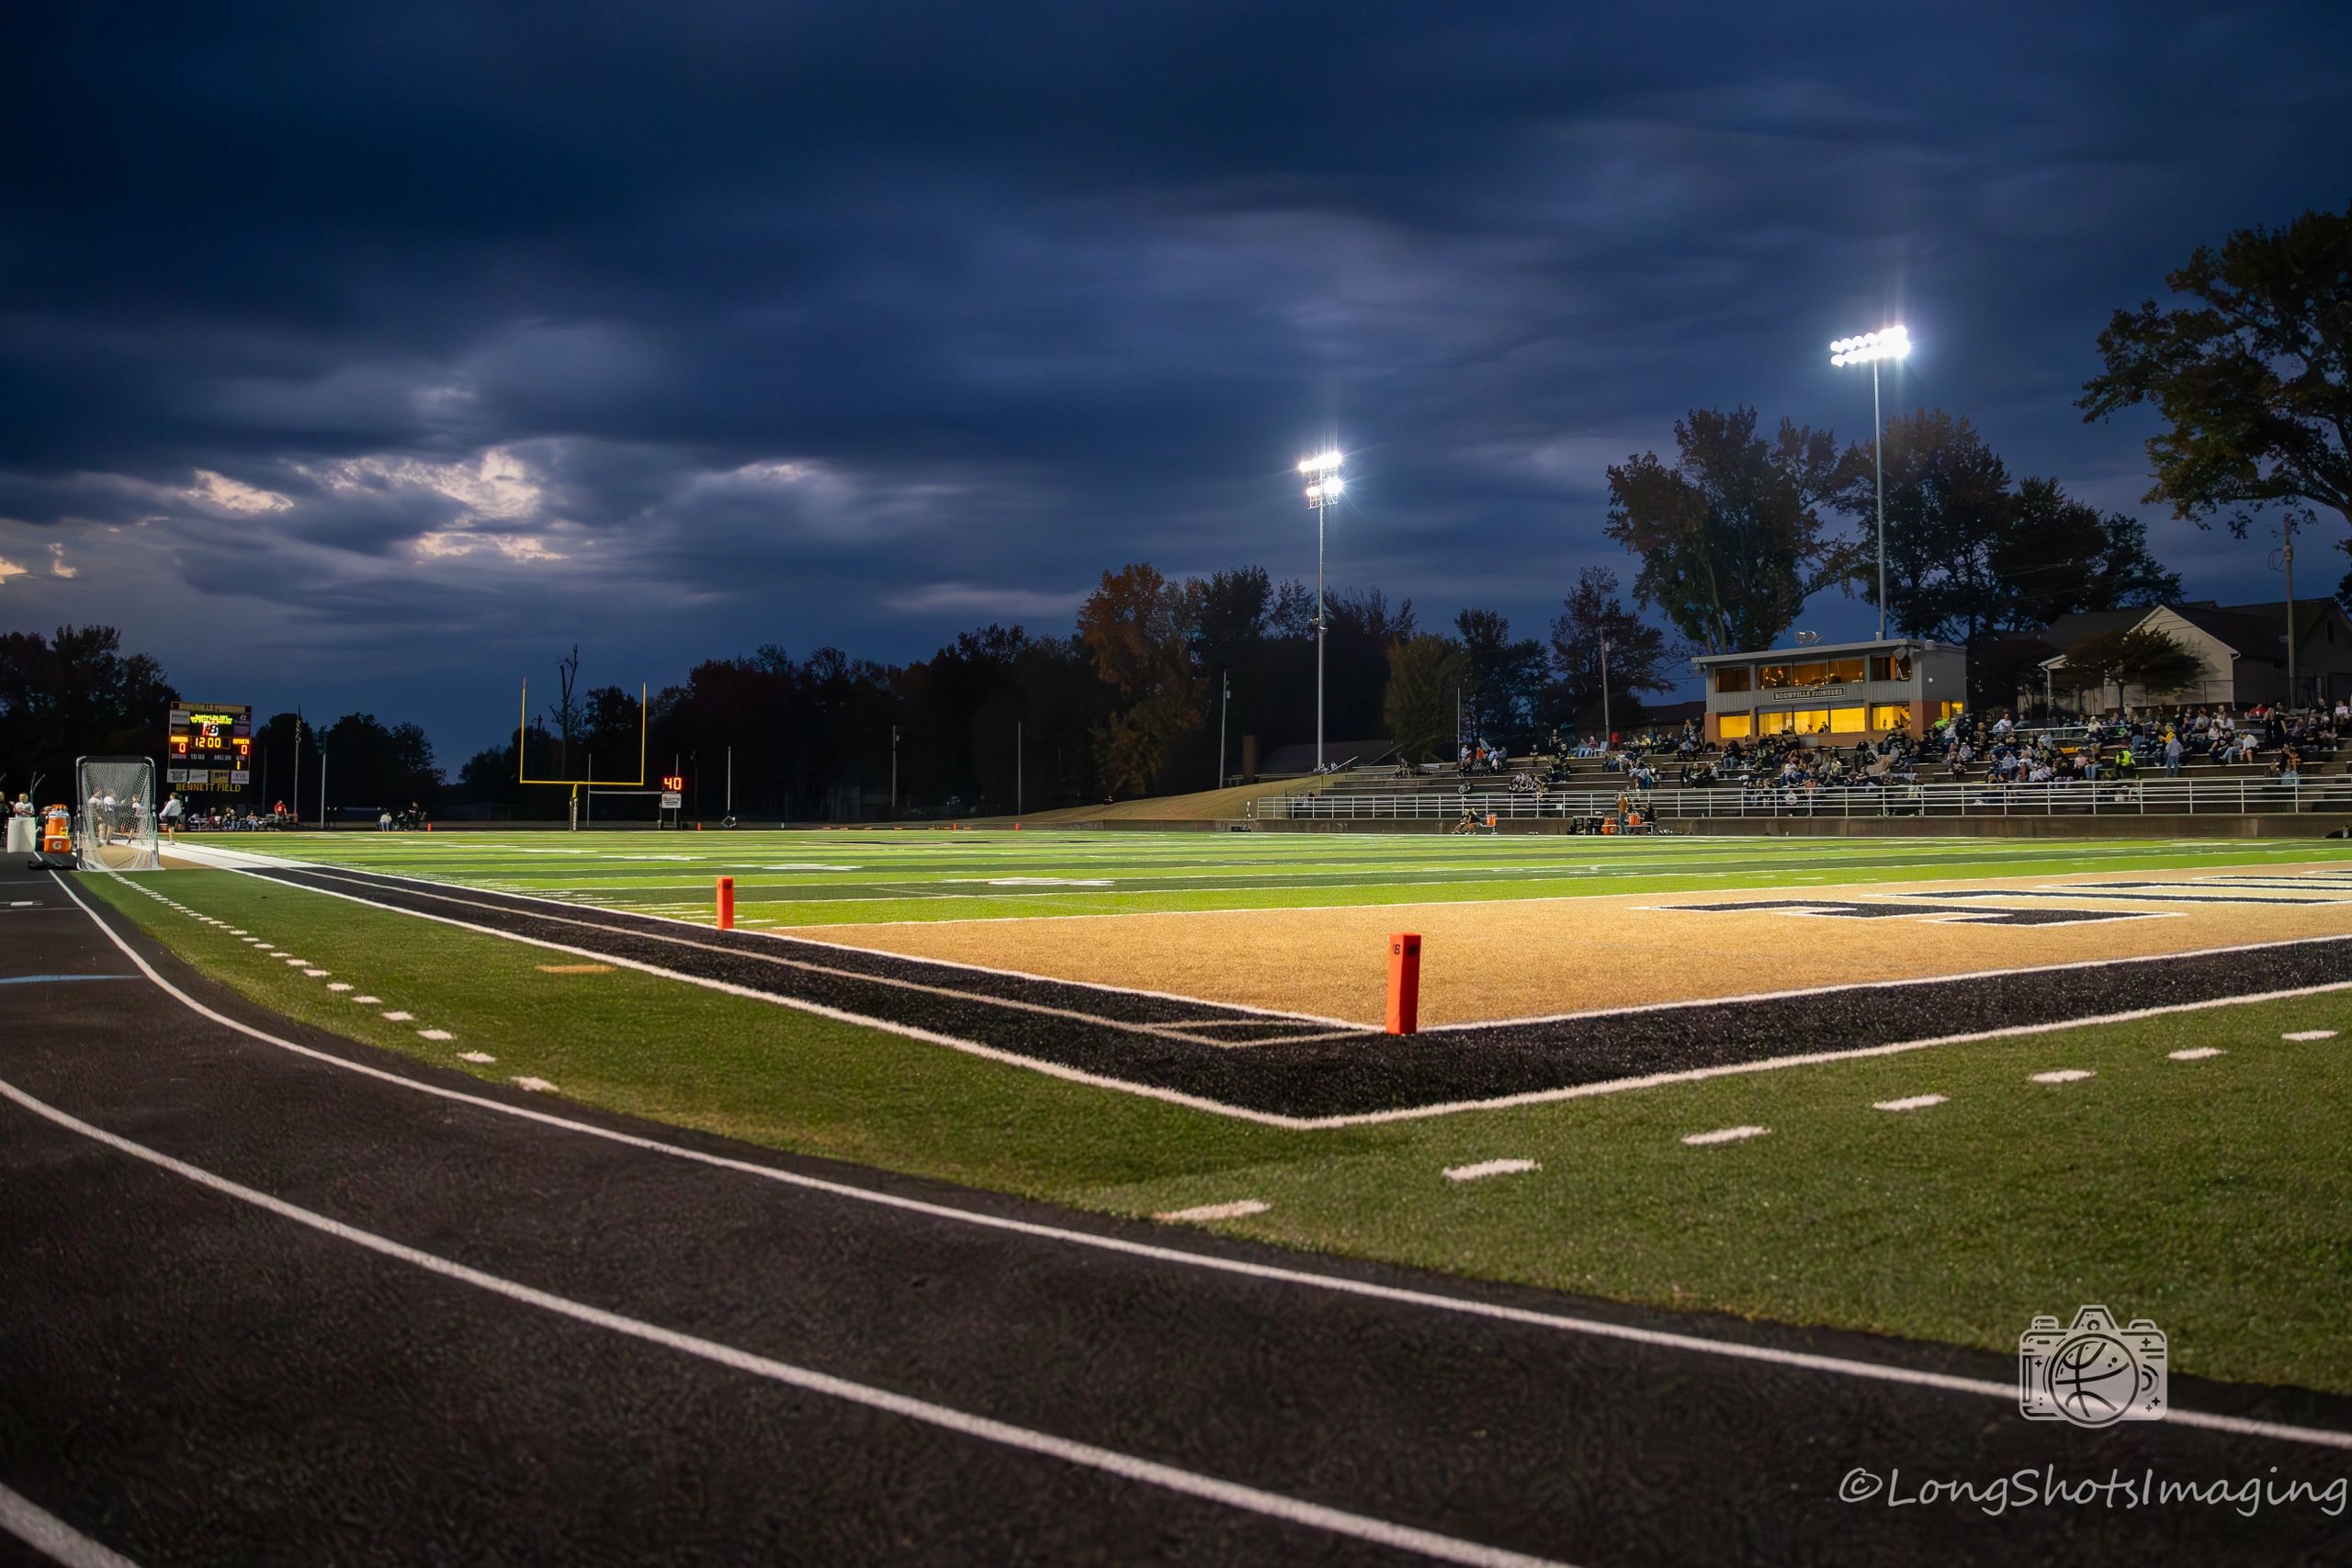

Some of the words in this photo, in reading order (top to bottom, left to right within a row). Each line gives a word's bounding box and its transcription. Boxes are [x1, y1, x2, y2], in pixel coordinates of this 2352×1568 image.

[1775, 691, 1810, 699] BOONVILLE
[179, 743, 186, 752] 0
[241, 745, 247, 754] 0
[175, 784, 216, 792] BENNETT
[217, 784, 241, 792] FIELD
[664, 777, 682, 790] 40
[52, 840, 62, 850] G
